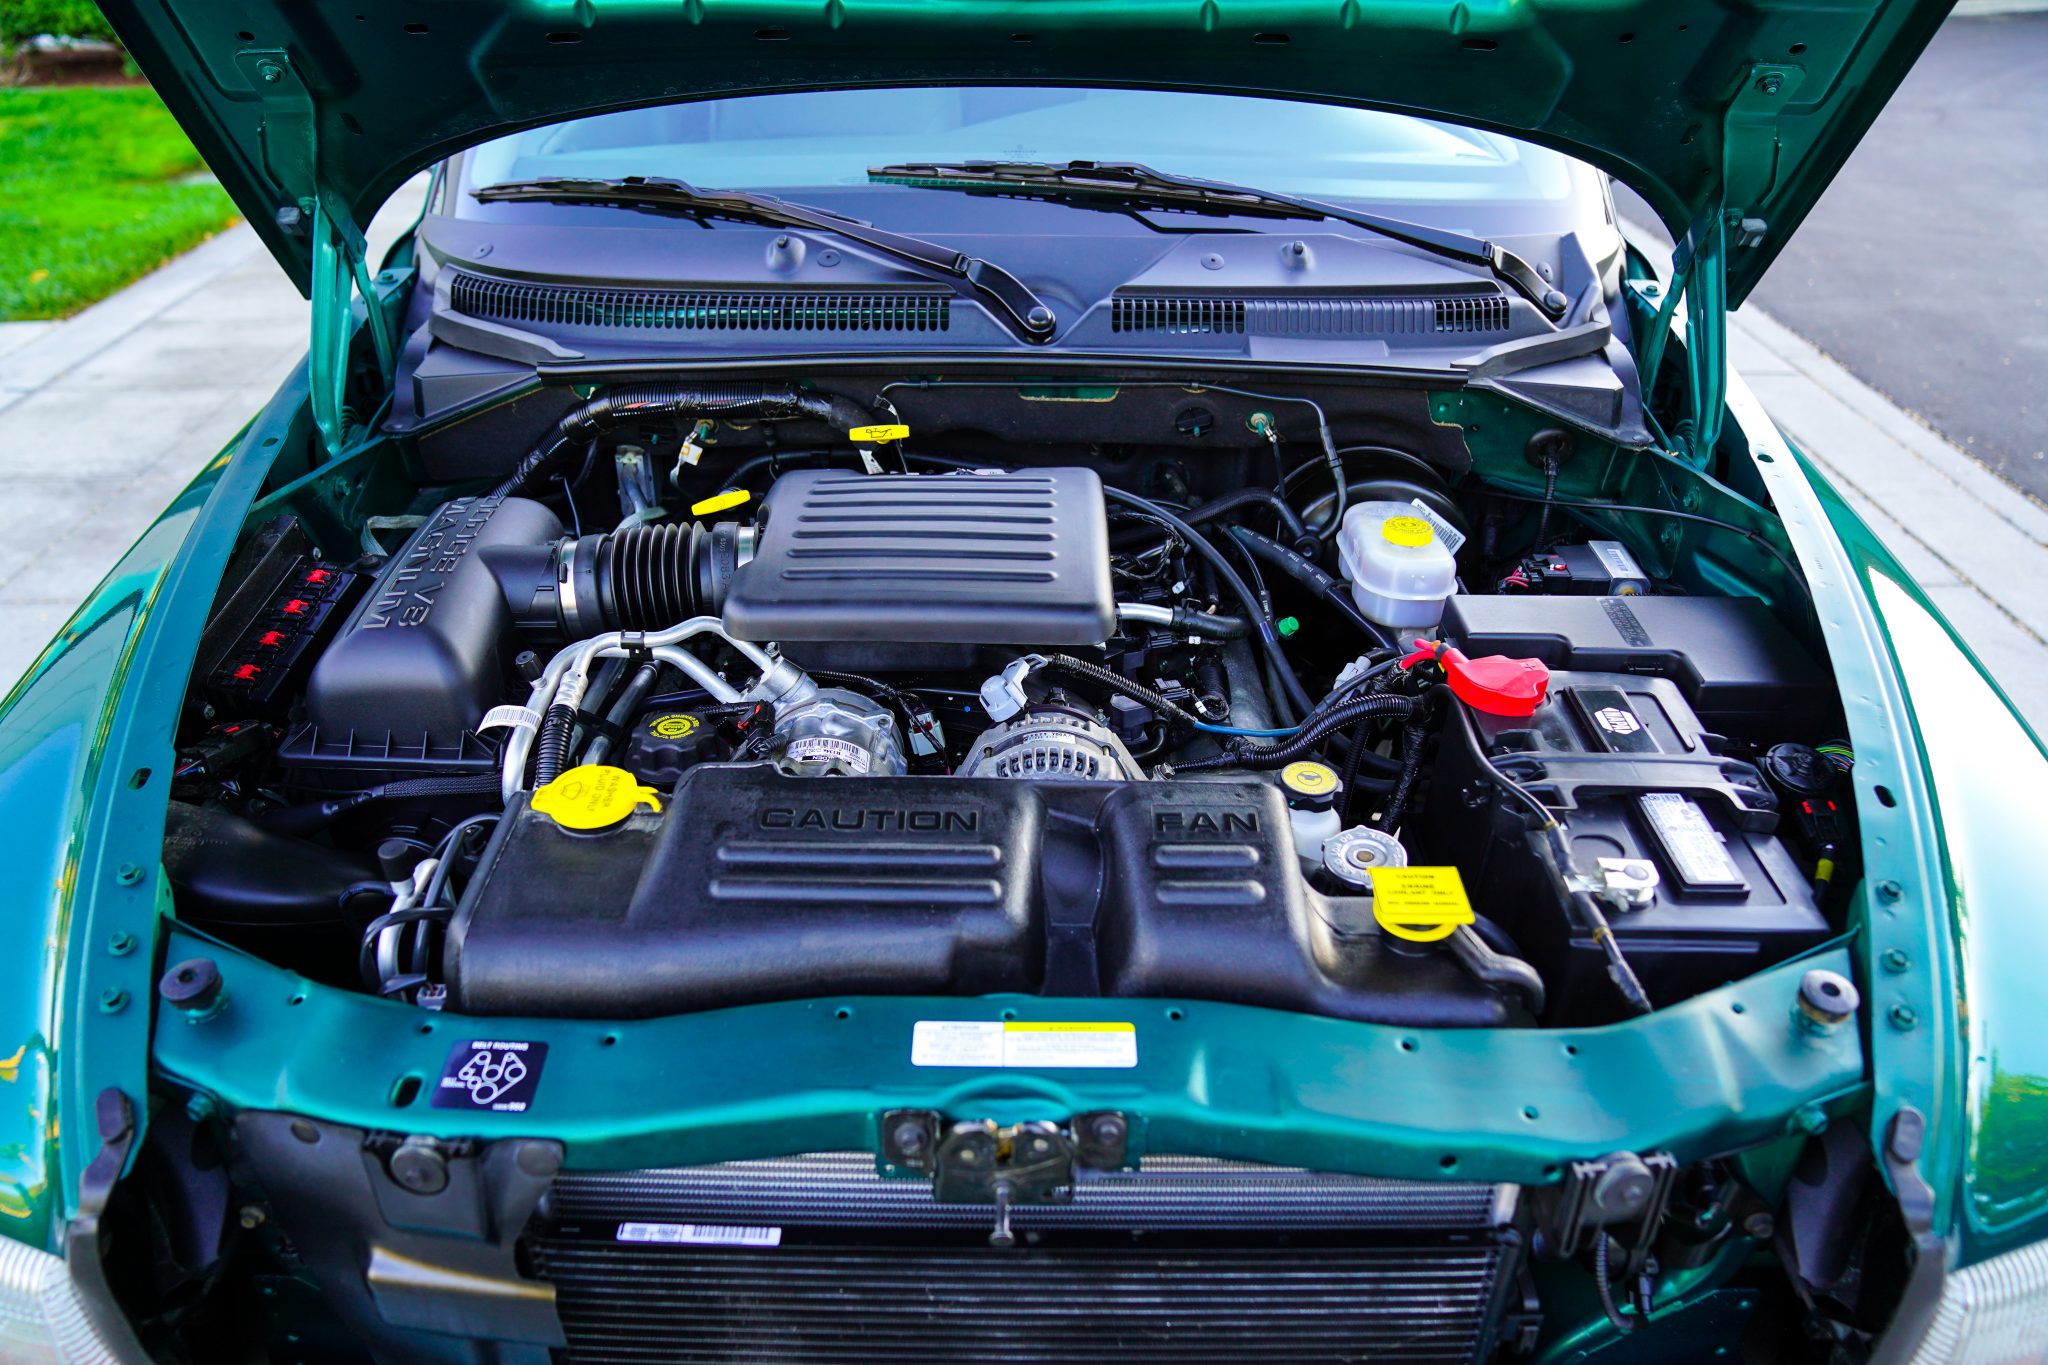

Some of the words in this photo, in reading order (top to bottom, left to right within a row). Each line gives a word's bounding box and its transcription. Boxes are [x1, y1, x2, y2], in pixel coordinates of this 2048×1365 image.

[362, 495, 478, 629] MAGNUM
[759, 807, 979, 832] CAUTION
[1154, 811, 1260, 833] FAN
[471, 1040, 493, 1050] BELT
[492, 1041, 530, 1052] ROUTING
